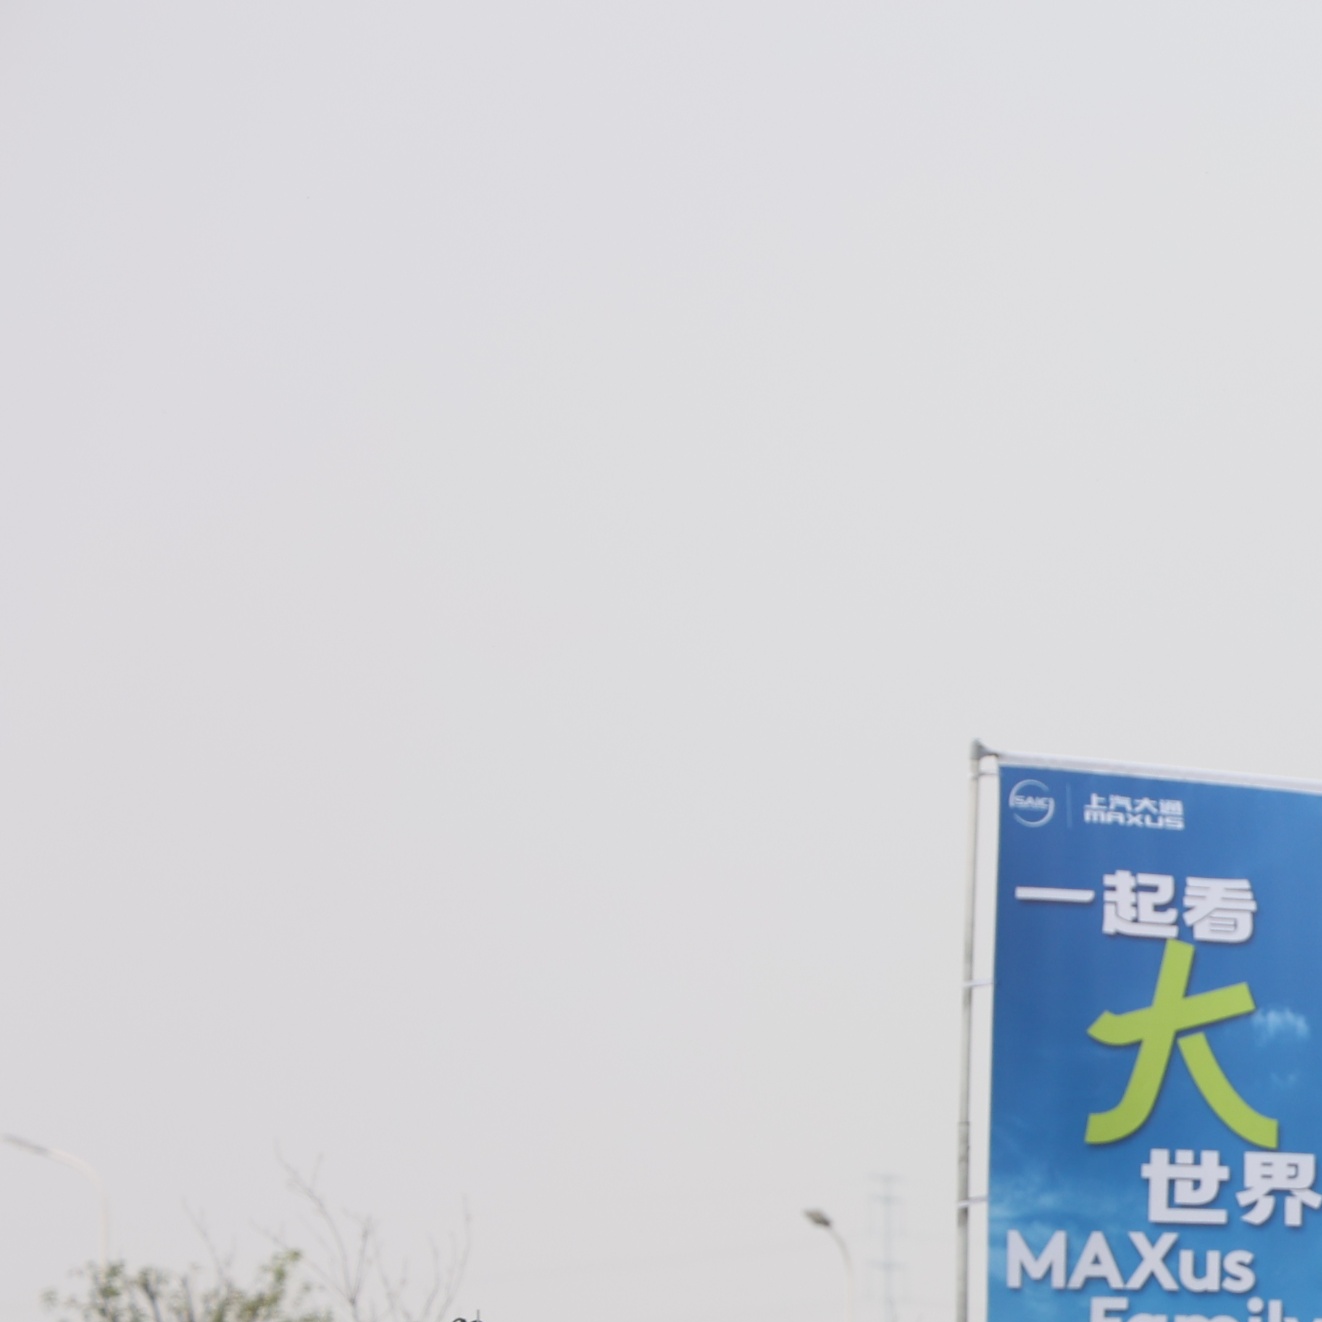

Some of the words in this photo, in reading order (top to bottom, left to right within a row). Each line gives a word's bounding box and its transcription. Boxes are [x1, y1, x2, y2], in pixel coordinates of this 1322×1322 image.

[1084, 792, 1184, 815] 上汽大通
[1084, 809, 1185, 830] MAXUS
[1015, 870, 1257, 943] 一起看
[1085, 938, 1279, 1149] 大
[1006, 1230, 1256, 1293] MAXus
